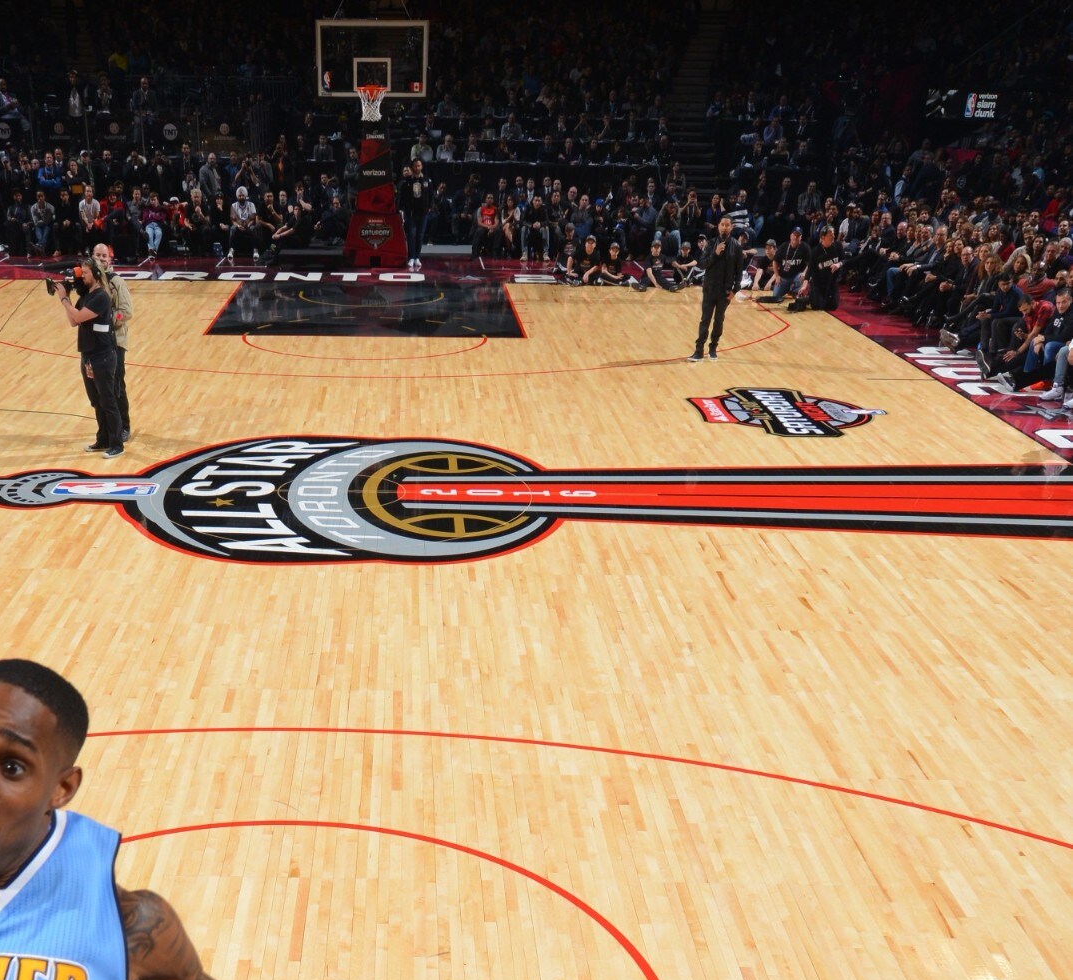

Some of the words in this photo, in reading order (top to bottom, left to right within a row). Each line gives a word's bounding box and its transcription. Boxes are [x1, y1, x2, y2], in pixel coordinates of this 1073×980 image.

[977, 100, 996, 108] slam
[974, 109, 995, 118] dunk
[363, 168, 386, 176] verizon
[747, 390, 826, 435] SATURDAY
[180, 440, 360, 497] STAR
[297, 450, 395, 543] TORONTO
[420, 488, 598, 498] 2016
